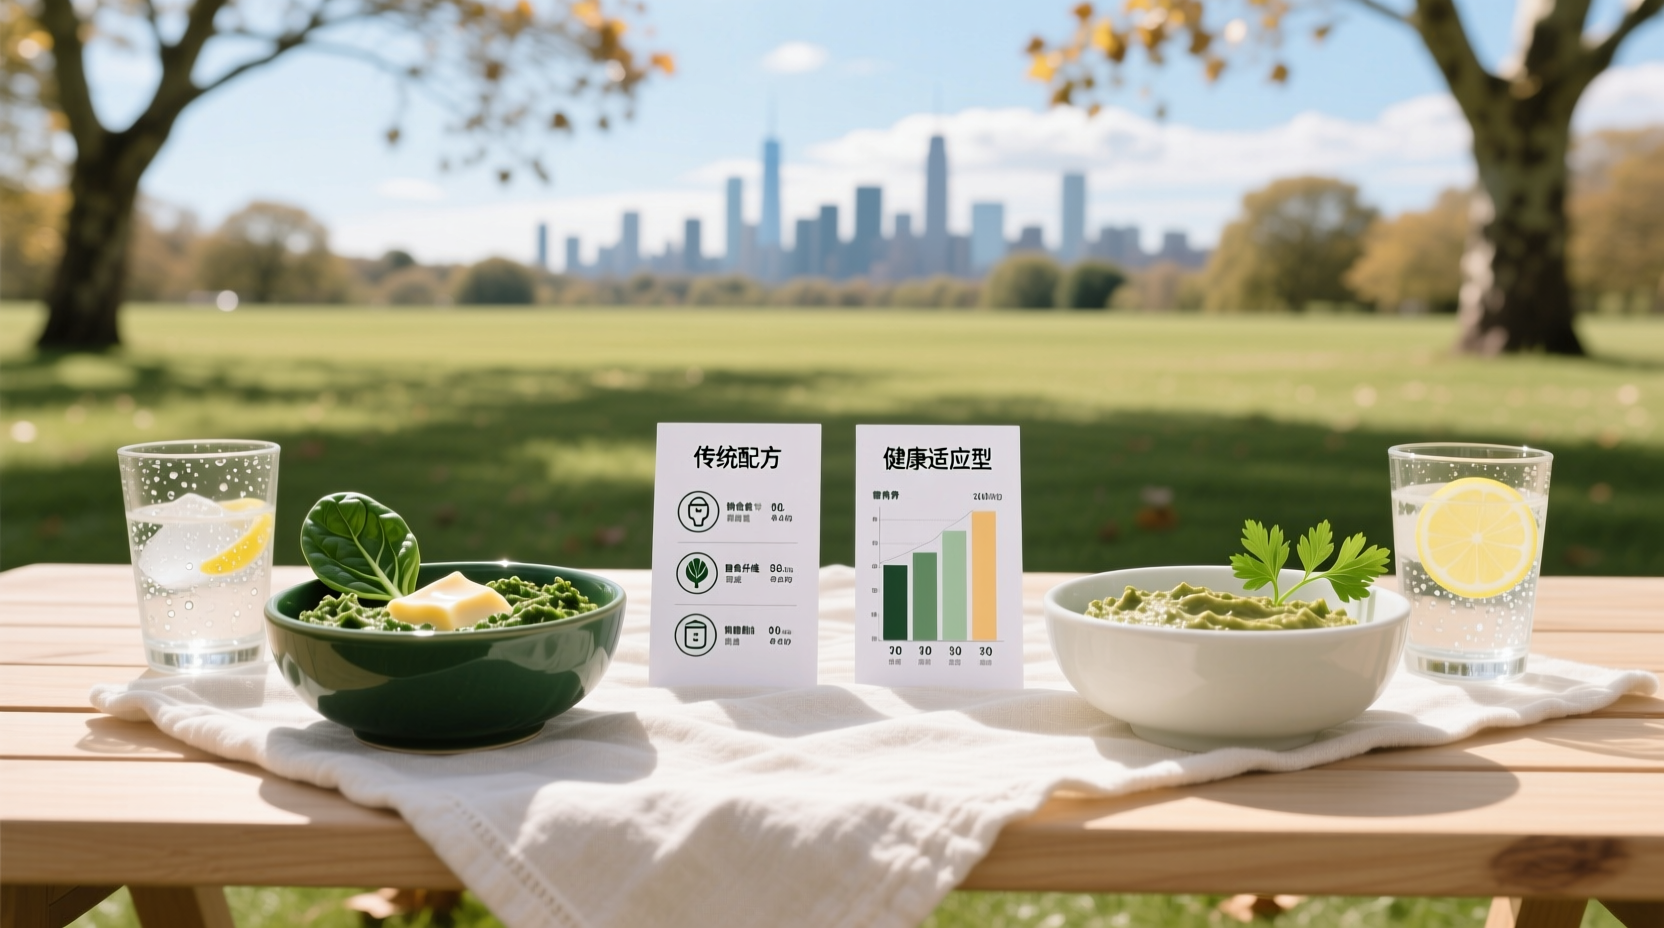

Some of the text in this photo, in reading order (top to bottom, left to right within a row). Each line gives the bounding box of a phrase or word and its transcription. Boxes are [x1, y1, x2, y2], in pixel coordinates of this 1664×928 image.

[693, 445, 782, 470] 传统配方
[883, 446, 993, 471] 健康适应型
